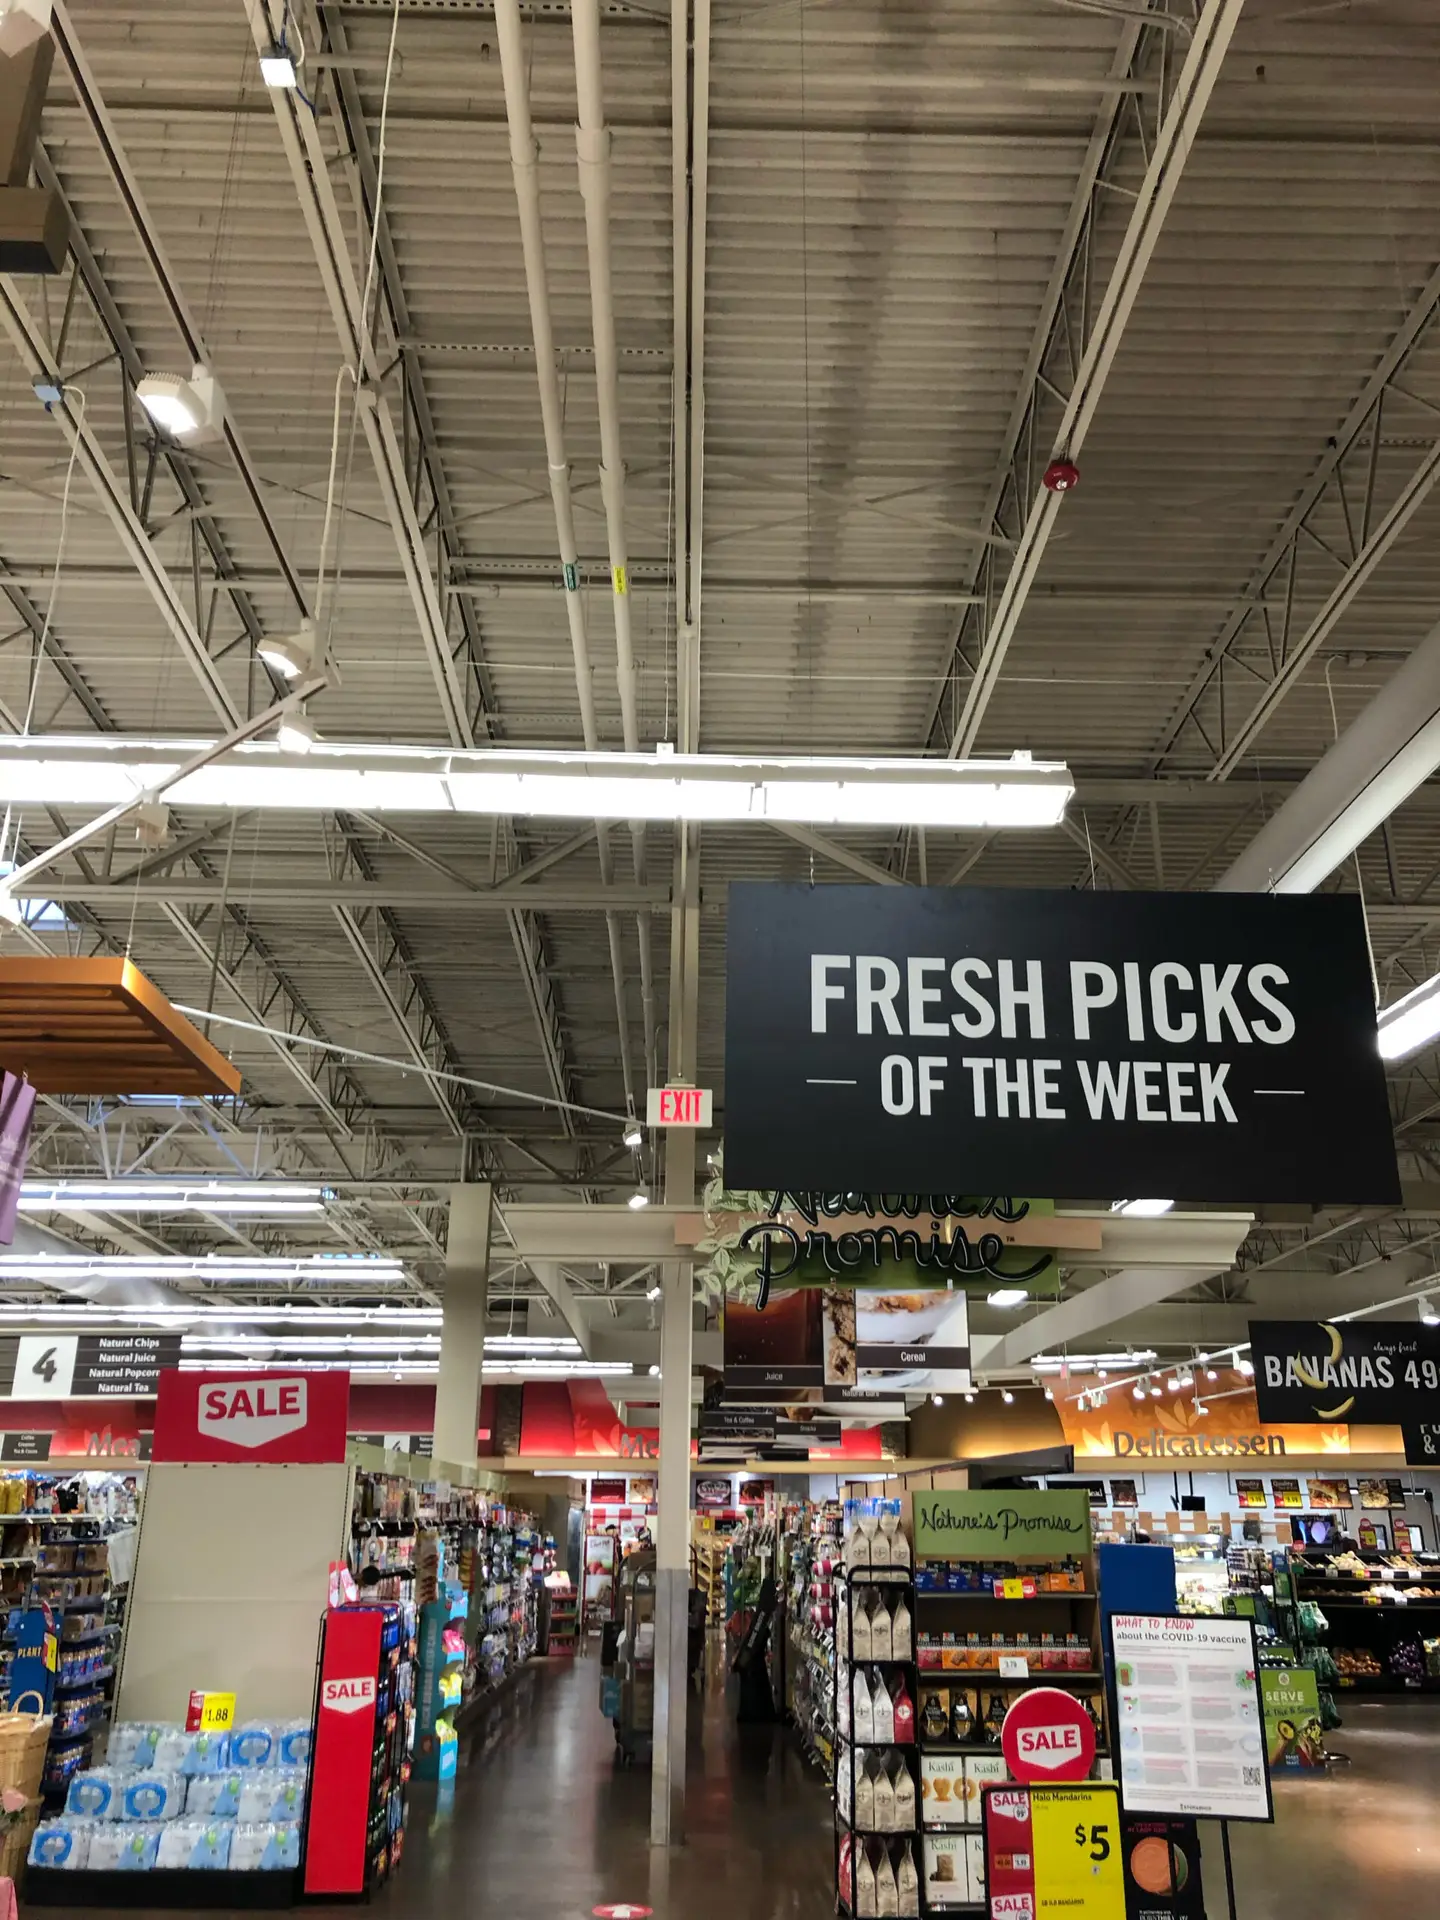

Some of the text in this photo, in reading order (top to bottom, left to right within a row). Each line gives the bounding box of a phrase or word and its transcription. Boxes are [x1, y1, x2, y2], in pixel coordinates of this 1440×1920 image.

[810, 954, 1296, 1045] FRESH PICKS
[880, 1054, 1238, 1123] OF THE WEEK
[660, 1091, 703, 1122] EXIT
[739, 1221, 1053, 1311] Promise
[99, 1337, 160, 1349] Natural Chips
[1373, 1341, 1418, 1356] always fresh
[99, 1353, 156, 1363] Natural Juice
[900, 1351, 926, 1362] Cereal
[32, 1346, 58, 1383] 4
[1264, 1355, 1395, 1389] BANANAS
[89, 1367, 124, 1378] Natural
[764, 1371, 783, 1381] Juice
[98, 1382, 149, 1392] Natural Tea
[205, 1386, 300, 1421] SALE
[1113, 1429, 1286, 1456] Delicatessen
[1424, 1436, 1437, 1454] &
[921, 1503, 1083, 1540] Nature's Promise
[1116, 1617, 1195, 1630] WHAT TO KNOW
[1117, 1632, 1247, 1644] about the COVID-19 vaccine
[327, 1681, 372, 1699] SALE
[1021, 1730, 1077, 1752] SALE
[928, 1761, 955, 1772] Kashi
[974, 1762, 1000, 1773] Kashi
[994, 1792, 1026, 1807] SALE
[1033, 1792, 1092, 1801] Halo Mandarins
[931, 1839, 957, 1851] Kashi
[1075, 1823, 1111, 1861] $5
[995, 1898, 1030, 1912] SALE
